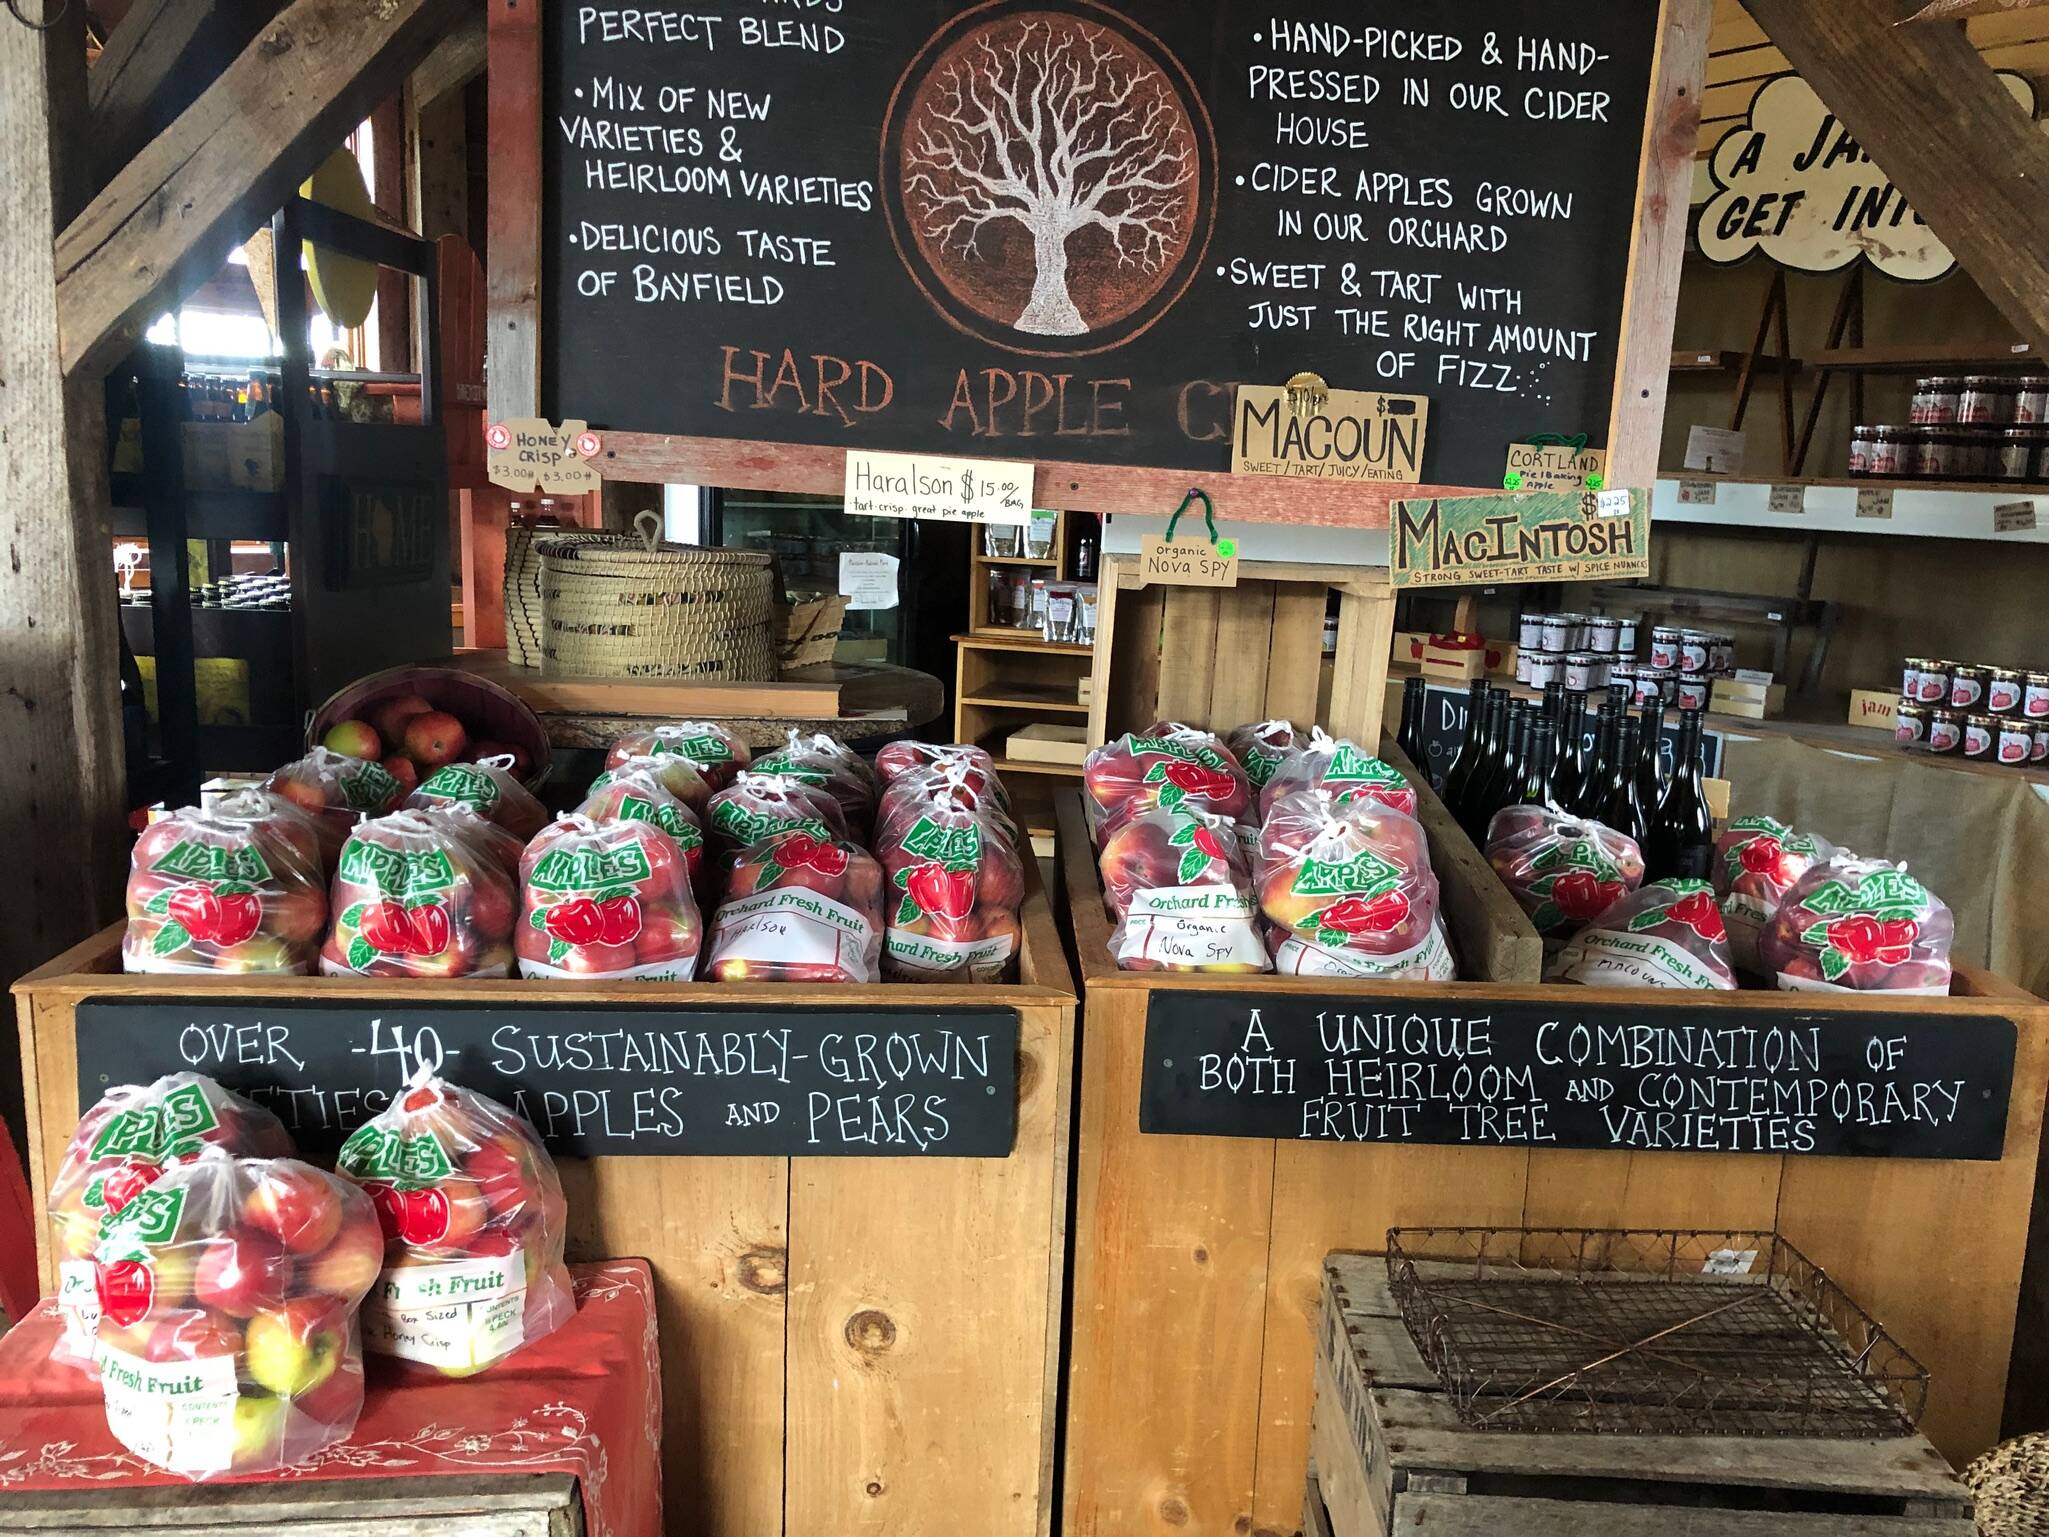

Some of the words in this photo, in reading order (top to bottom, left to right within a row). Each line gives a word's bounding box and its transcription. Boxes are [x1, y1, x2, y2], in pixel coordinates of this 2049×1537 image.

[579, 8, 721, 51] PERFECT
[739, 17, 845, 53] BLEND
[1270, 18, 1462, 62] HAND-PICKED
[1481, 32, 1503, 65] &
[1517, 36, 1609, 75] HAND-
[593, 76, 644, 111] MIX
[659, 86, 696, 113] OF
[708, 88, 771, 121] NEW
[1249, 65, 1380, 104] PRESSED
[1403, 78, 1429, 106] IN
[1449, 83, 1509, 117] OUR
[1524, 87, 1610, 123] CIDER
[559, 115, 703, 156] VARIETIES
[719, 126, 742, 163] &
[1276, 112, 1369, 148] HOUSE
[1729, 132, 1766, 178] A
[1793, 114, 1872, 171] JA
[585, 160, 732, 198] HEIRLOOM
[740, 170, 873, 212] VARIETIES
[1251, 163, 1341, 197] CIDER
[1355, 169, 1453, 208] APPLES
[1476, 182, 1573, 219] GROWN
[1278, 210, 1301, 237] IN
[1313, 212, 1368, 242] OUR
[1388, 218, 1507, 253] ORCHARD
[1716, 190, 1805, 241] GET
[581, 221, 721, 255] DELICIOUS
[737, 230, 836, 266] TASTE
[577, 270, 617, 296] OF
[633, 264, 784, 305] BAYFIELD
[1230, 258, 1325, 289] SWEET
[1341, 262, 1362, 297] &
[1371, 270, 1441, 304] TART
[1458, 283, 1521, 315] WITH
[1248, 302, 1316, 330] JUST
[1335, 308, 1390, 337] THE
[1404, 313, 1481, 347] RIGHT
[1488, 327, 1597, 361] AMOUNT
[1376, 350, 1415, 379] OF
[713, 345, 894, 428] HARD
[936, 367, 1132, 438] APPLE
[516, 432, 571, 453] HONEY
[1241, 398, 1418, 471] MACOUN
[519, 450, 562, 467] CRISP
[856, 461, 953, 495] Haralson
[1510, 450, 1599, 472] CORTLAND
[912, 504, 936, 518] great
[942, 507, 957, 518] pie
[961, 509, 985, 519] apple
[1415, 571, 1461, 583] STRONG
[1536, 564, 1562, 574] TASTE
[1584, 562, 1610, 573] SPICE
[716, 896, 777, 922] Orchard
[777, 894, 823, 915] Fresh
[826, 911, 864, 934] Fruit
[1149, 894, 1210, 911] Orchard
[1735, 902, 1768, 922] Fres
[920, 945, 962, 963] Fresh
[1160, 936, 1194, 957] Nova
[1584, 934, 1650, 954] Orchard
[1650, 944, 1693, 978] Fresh
[180, 1022, 305, 1072] OVER
[1241, 1009, 1275, 1052] A
[1316, 1012, 1492, 1061] UNIQUE
[1536, 1021, 1820, 1074] COMBINATION
[1866, 1035, 1908, 1073] OF
[1199, 1052, 1296, 1094] BOTH
[1324, 1057, 1542, 1102] HEIRLOOM
[1565, 1077, 1614, 1101] AND
[1638, 1072, 1966, 1127] CONTEMPORARY
[725, 1101, 781, 1127] AND
[808, 1092, 950, 1152] PEARS
[1300, 1097, 1421, 1142] FRUIT
[1449, 1103, 1556, 1143] TREE
[1599, 1104, 1817, 1152] VARIETIES
[448, 1270, 505, 1294] Fruit
[425, 1307, 458, 1321] Sized
[421, 1333, 452, 1350] Crisp
[109, 1360, 142, 1392] Fresh
[147, 1375, 204, 1395] Fruit
